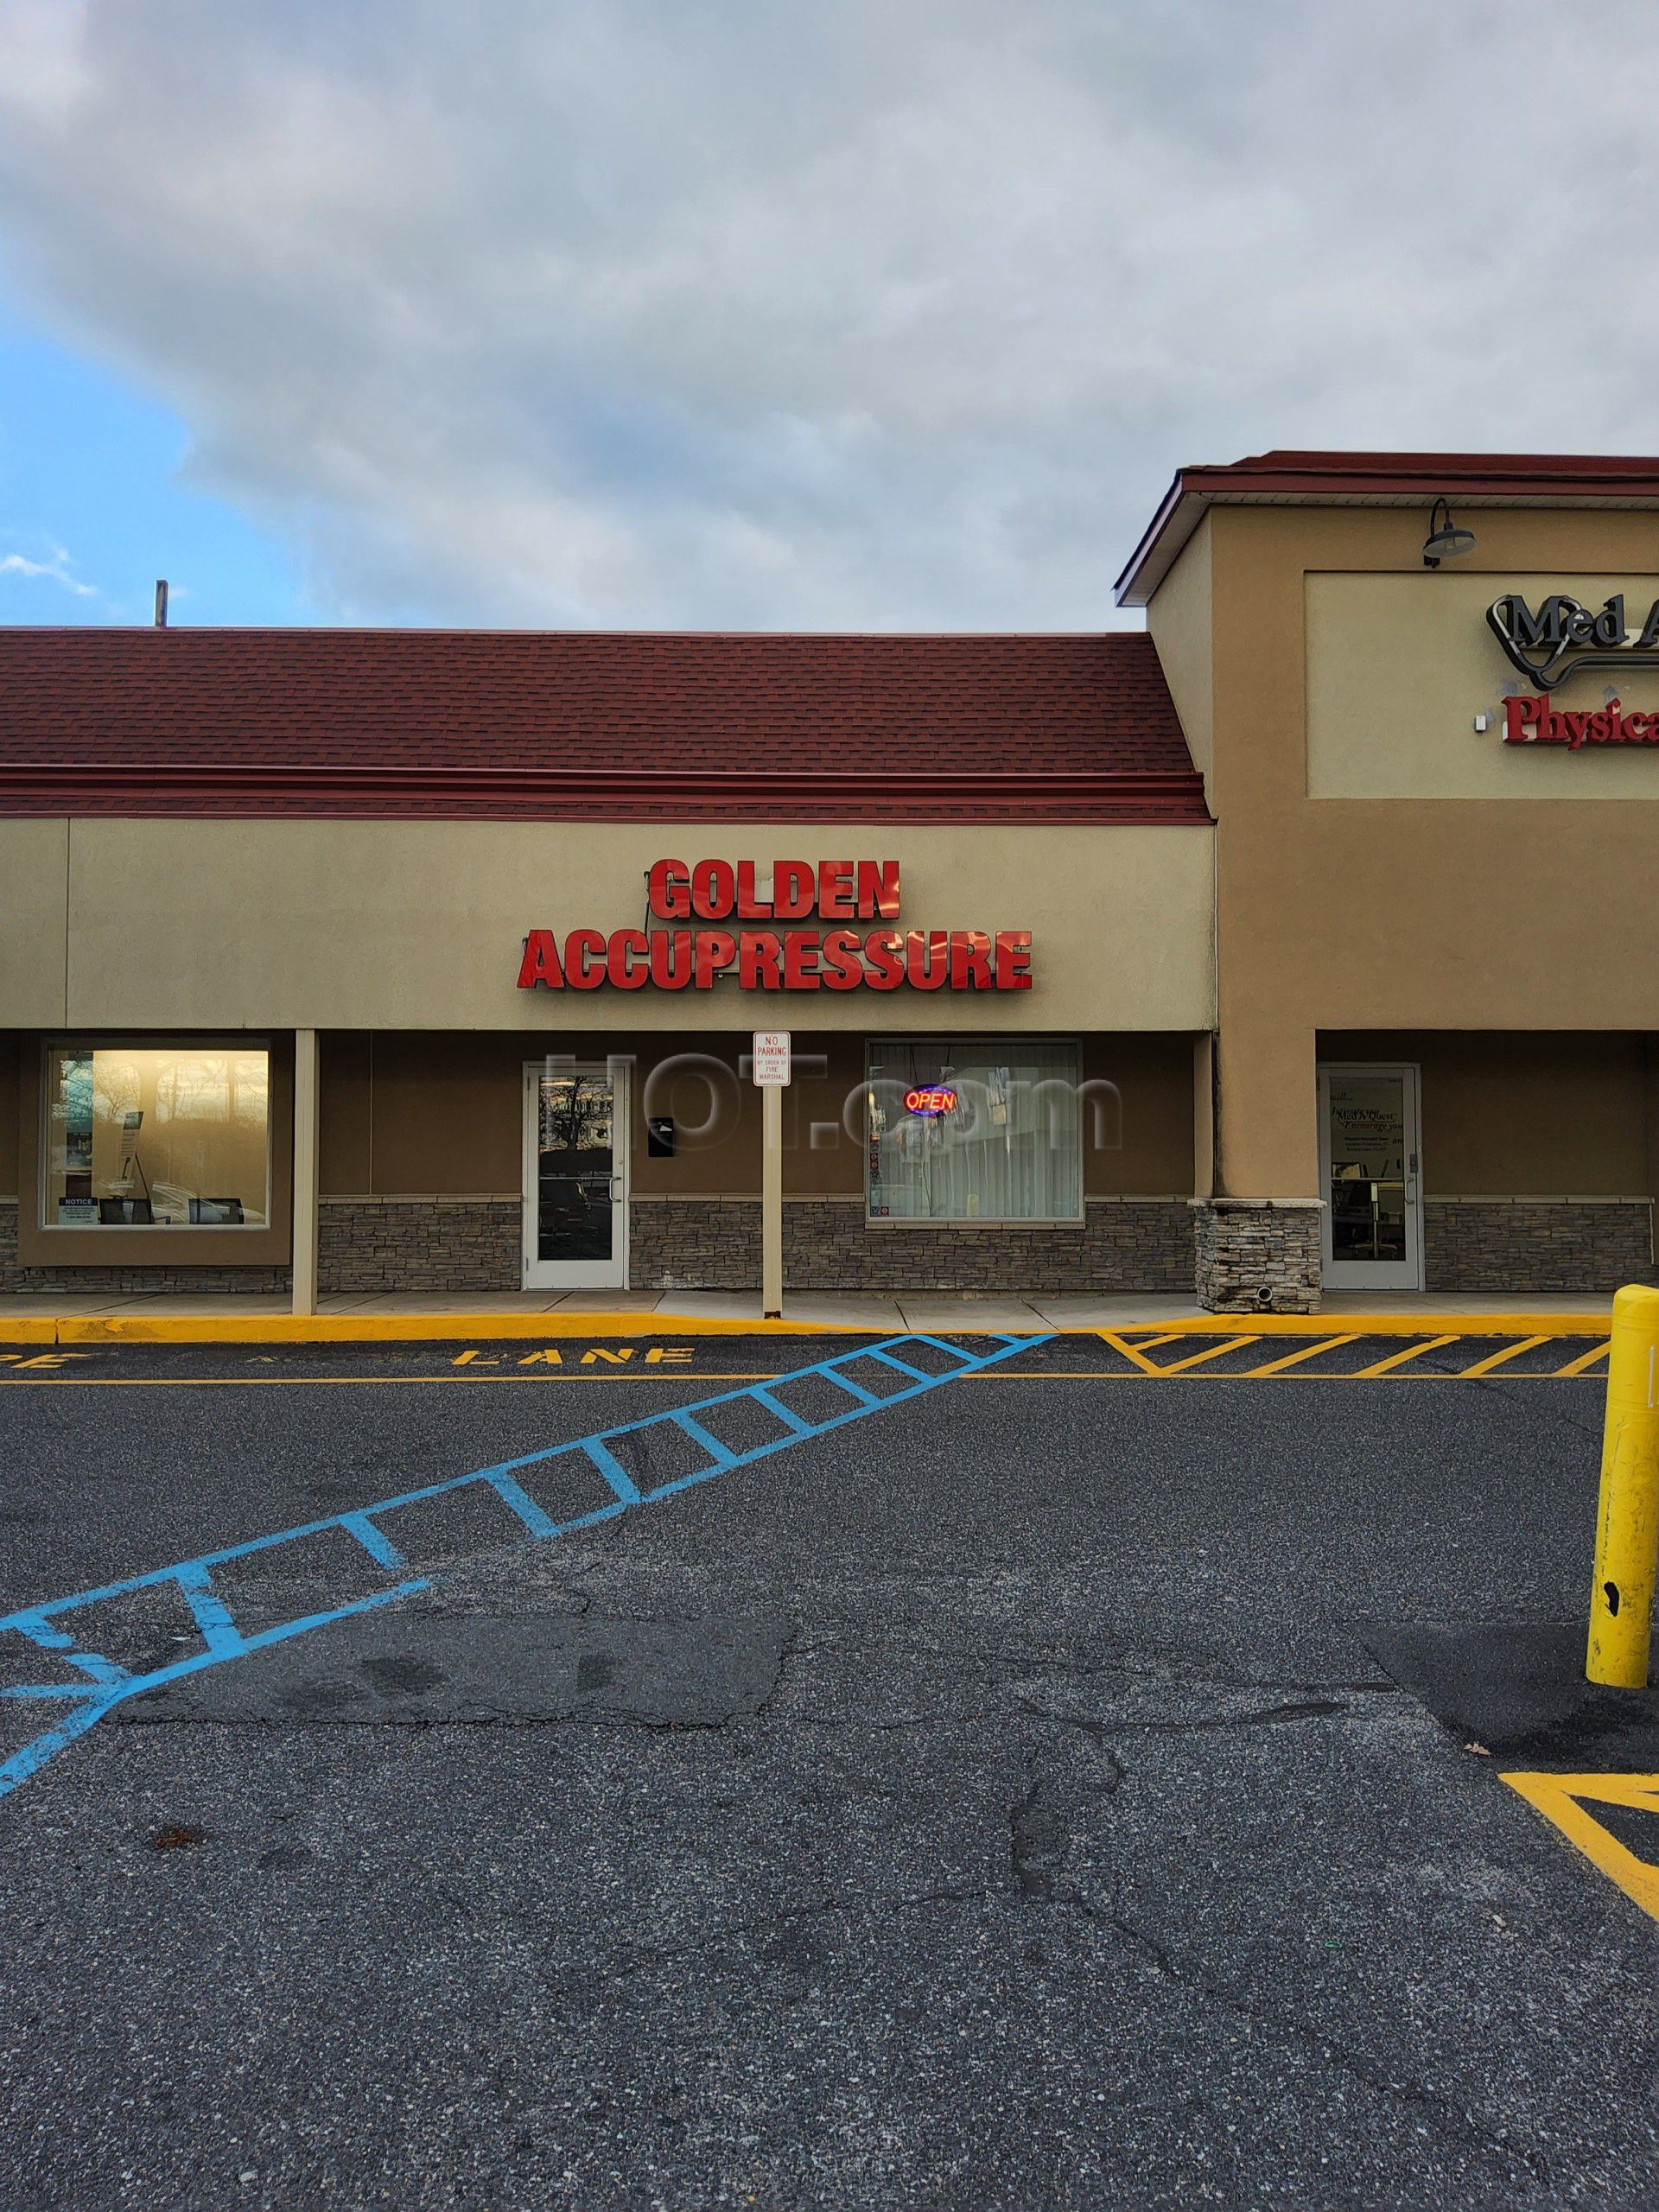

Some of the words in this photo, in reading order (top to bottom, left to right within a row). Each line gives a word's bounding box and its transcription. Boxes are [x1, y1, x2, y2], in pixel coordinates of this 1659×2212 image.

[1508, 594, 1630, 647] Med
[649, 859, 899, 919] GOLDEN
[517, 929, 1033, 990] ACCUPRESSURE
[766, 1036, 779, 1046] NO
[758, 1046, 786, 1056] PARKING
[906, 1093, 955, 1110] OPEN
[451, 1348, 696, 1364] LANE
